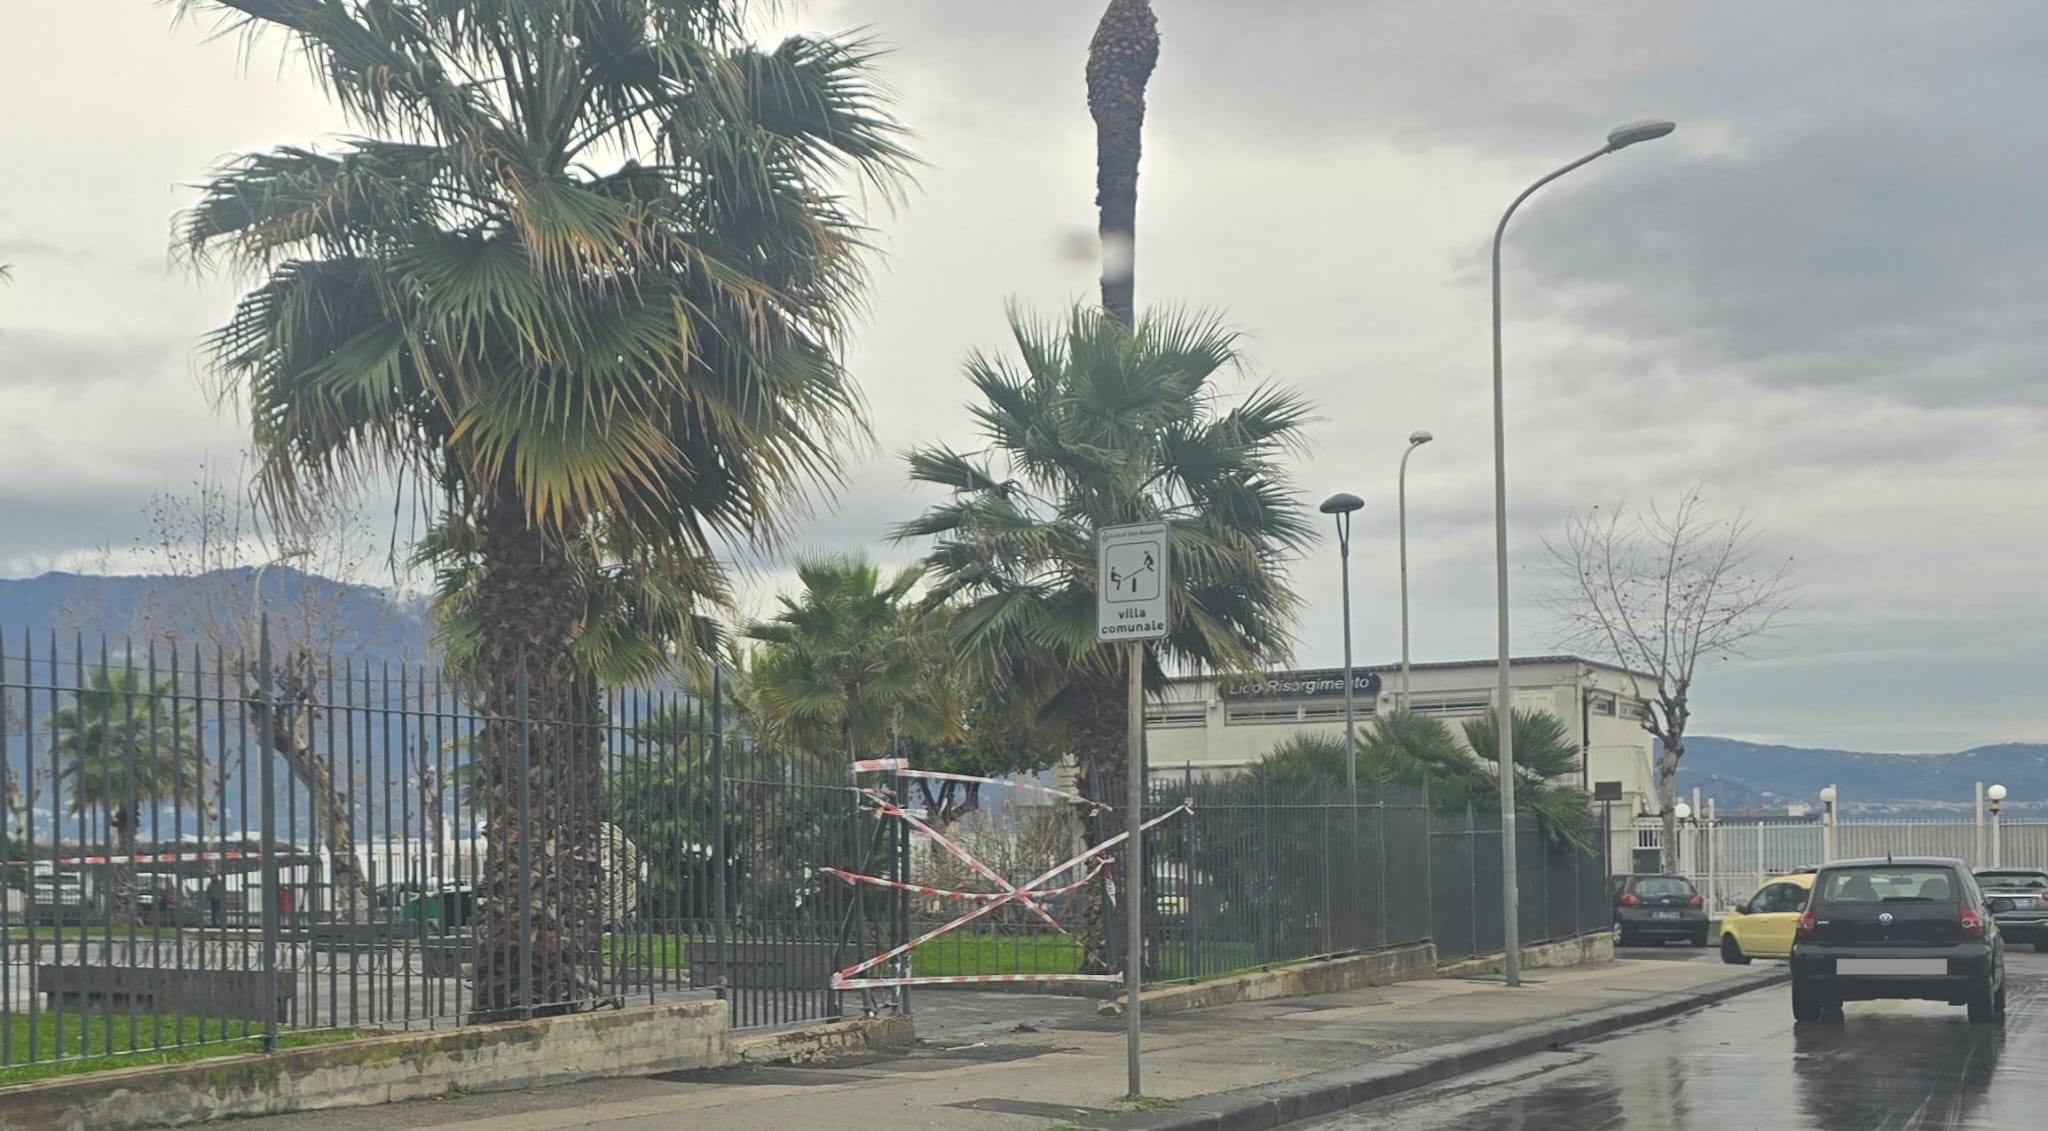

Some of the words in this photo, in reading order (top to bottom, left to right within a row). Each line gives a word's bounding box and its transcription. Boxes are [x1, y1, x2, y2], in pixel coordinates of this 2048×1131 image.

[1118, 607, 1146, 619] villa
[1101, 619, 1165, 634] comunale
[1267, 676, 1370, 695] Risorgimeto
